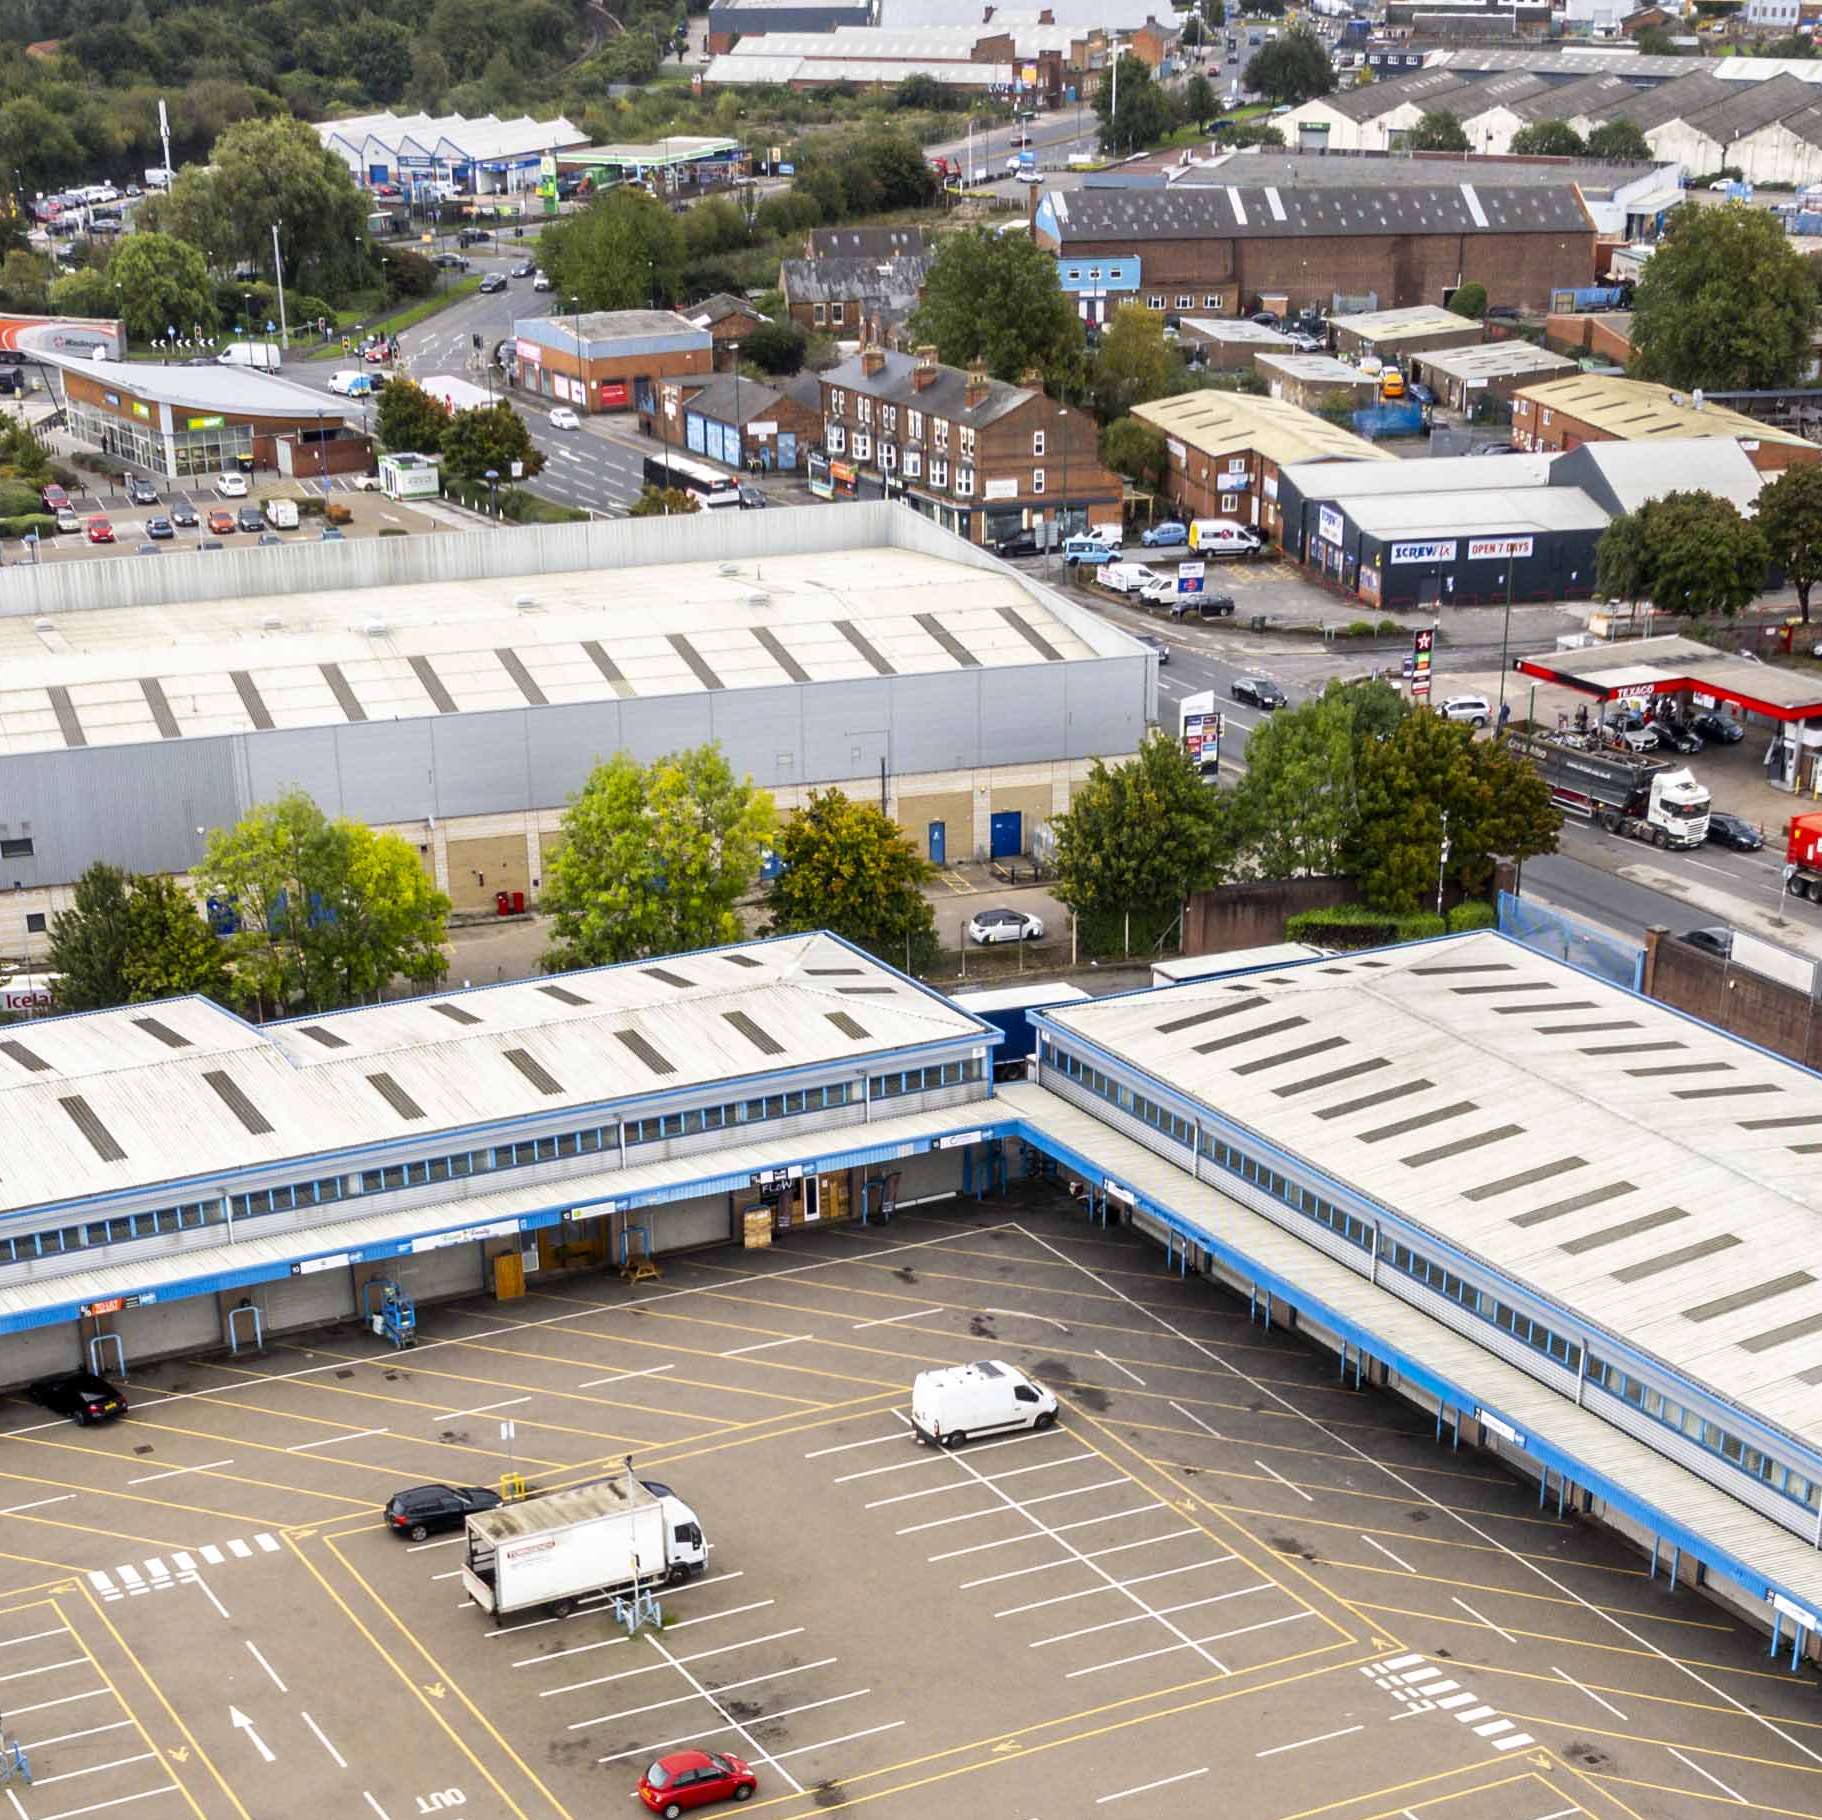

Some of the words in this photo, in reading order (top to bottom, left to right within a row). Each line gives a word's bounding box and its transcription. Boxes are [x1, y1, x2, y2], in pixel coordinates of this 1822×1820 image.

[1472, 544, 1496, 555] OPEN
[1616, 684, 1655, 698] TEXACO
[416, 1788, 467, 1814] OUT
